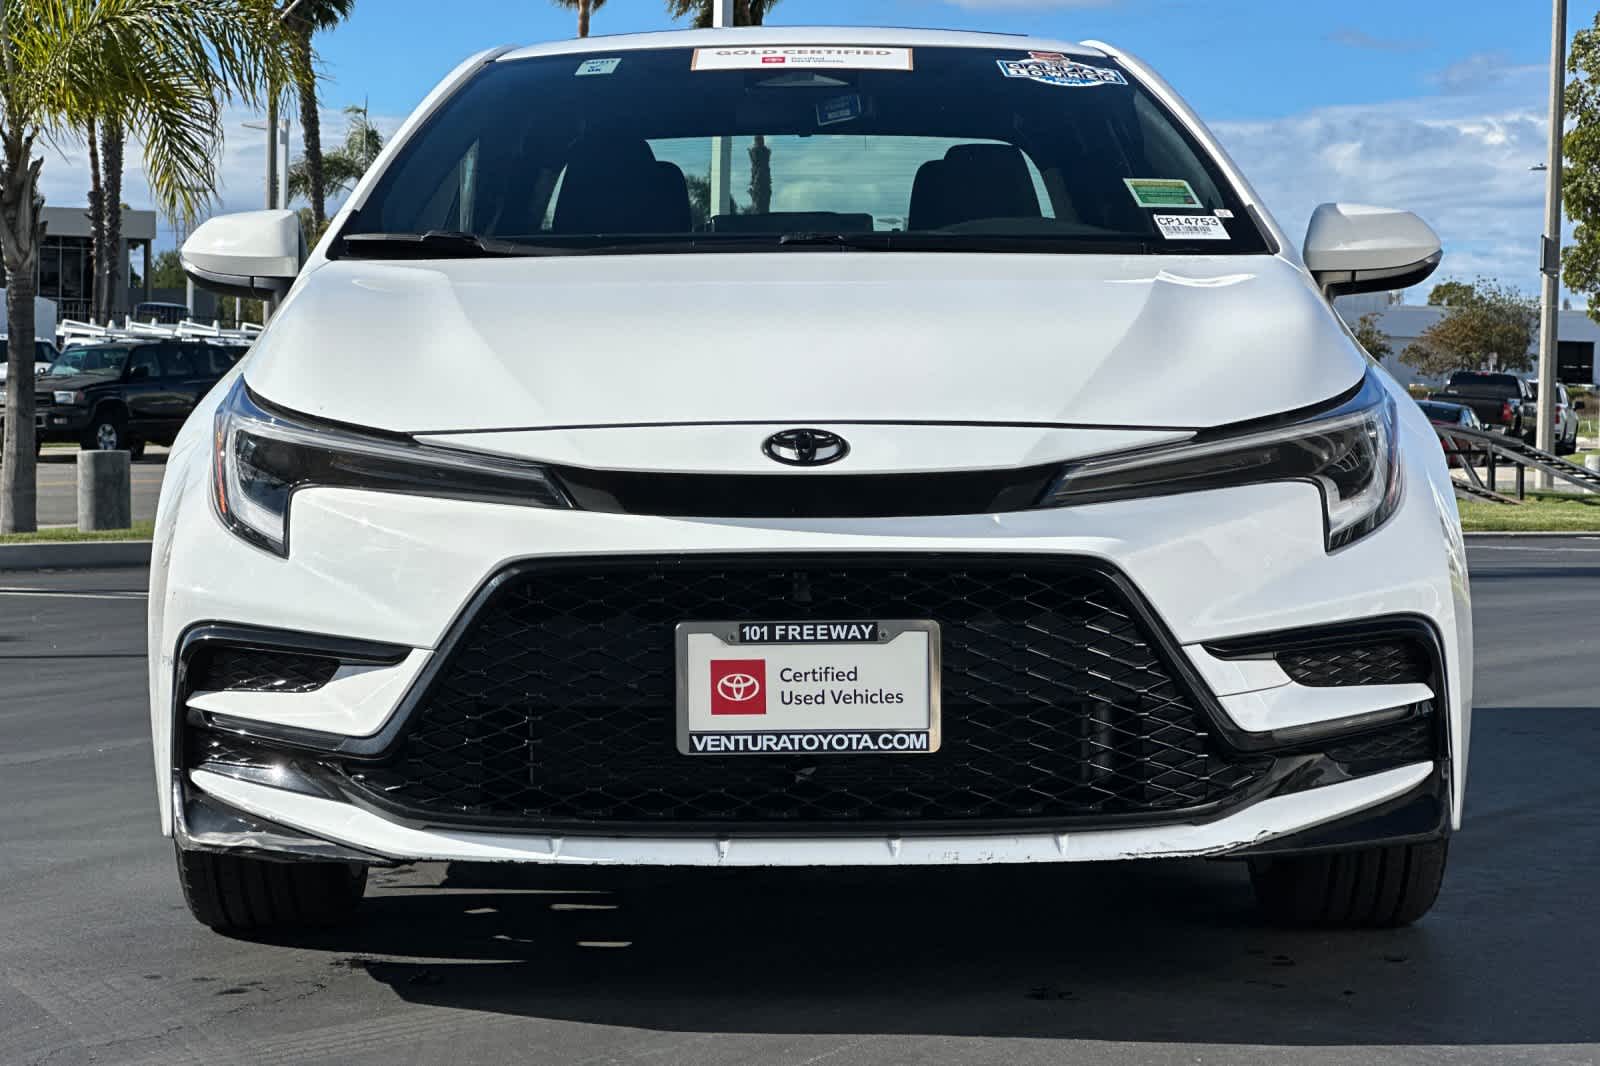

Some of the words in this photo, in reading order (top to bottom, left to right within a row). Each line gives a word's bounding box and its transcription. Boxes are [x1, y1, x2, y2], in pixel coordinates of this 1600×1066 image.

[1157, 216, 1219, 226] CP14753
[742, 625, 769, 641] 101
[775, 624, 874, 640] FREEWAY
[780, 666, 858, 682] Certified
[780, 690, 825, 705] Used
[831, 688, 904, 704] Vehicles
[691, 733, 927, 751] VENTURATOYOTA.COM
